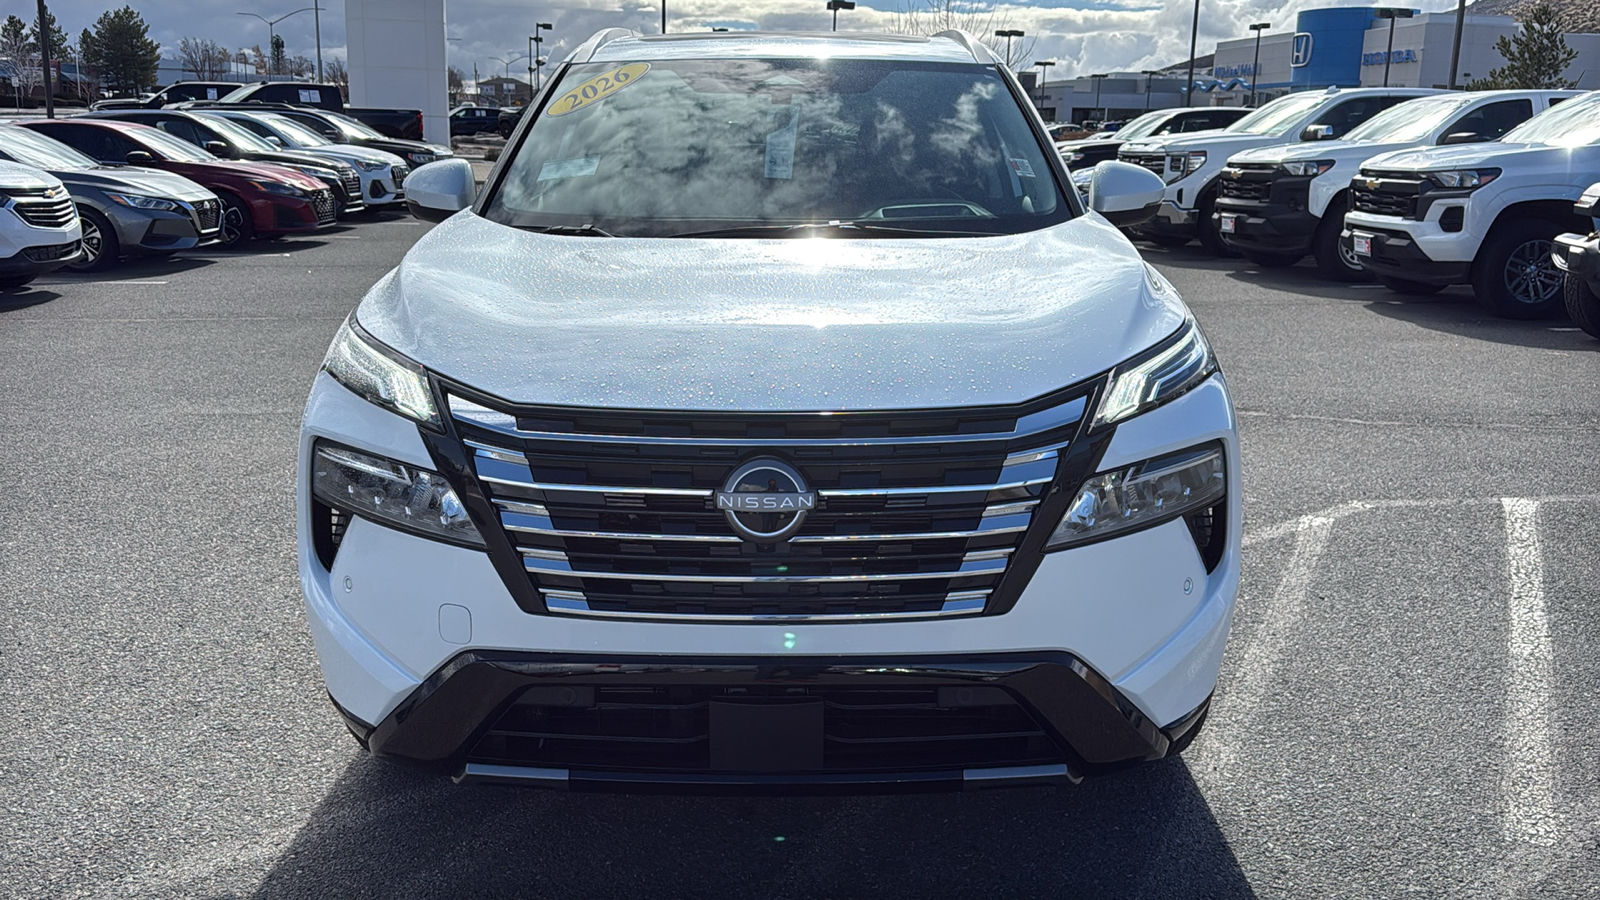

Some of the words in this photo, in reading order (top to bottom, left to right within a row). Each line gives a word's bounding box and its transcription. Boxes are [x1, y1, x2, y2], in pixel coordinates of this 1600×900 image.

[1362, 49, 1417, 65] HONDA
[564, 67, 630, 110] 2026
[719, 495, 812, 508] NISSAN
